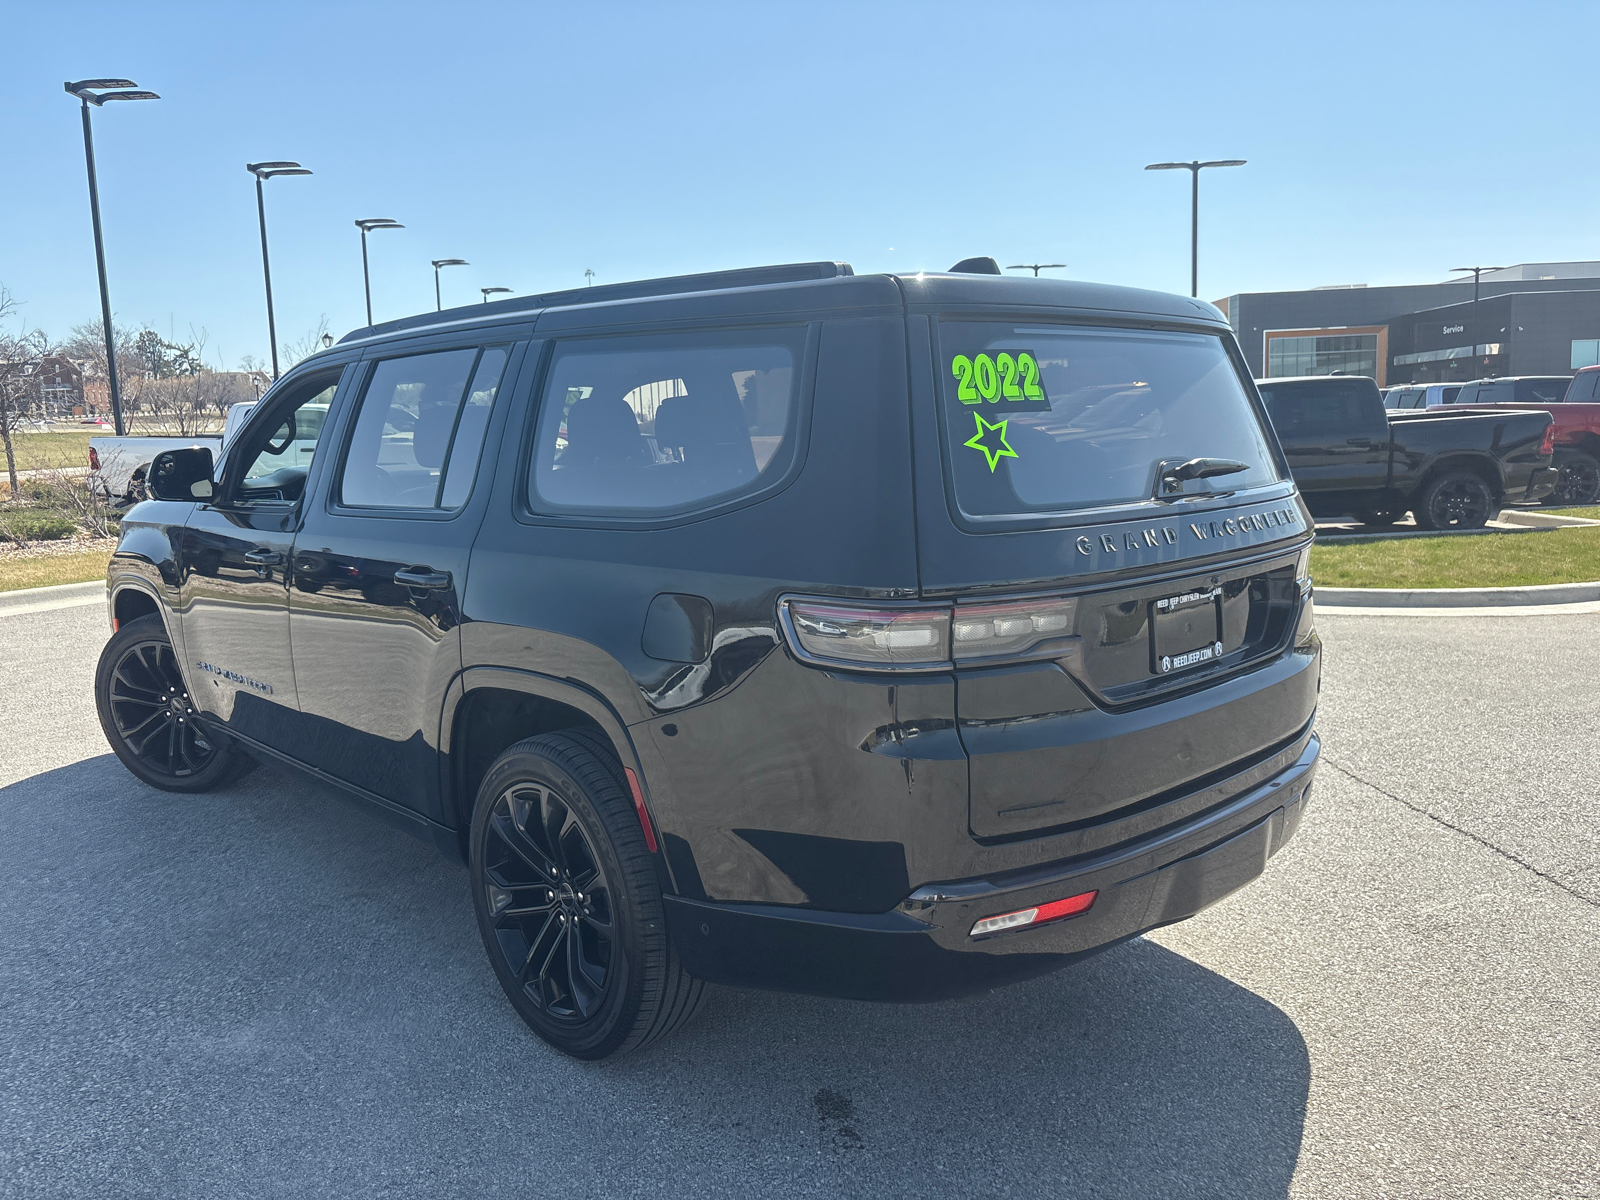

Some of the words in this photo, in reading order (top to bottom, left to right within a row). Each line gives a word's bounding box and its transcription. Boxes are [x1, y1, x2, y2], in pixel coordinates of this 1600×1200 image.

[1442, 324, 1464, 335] Service
[952, 352, 1045, 405] 2022
[1075, 526, 1178, 556] GRAND
[1190, 508, 1296, 540] WAGONEER
[1157, 599, 1168, 608] REED
[1170, 596, 1179, 605] JEEP
[1174, 648, 1212, 668] REEDJEEP.COM
